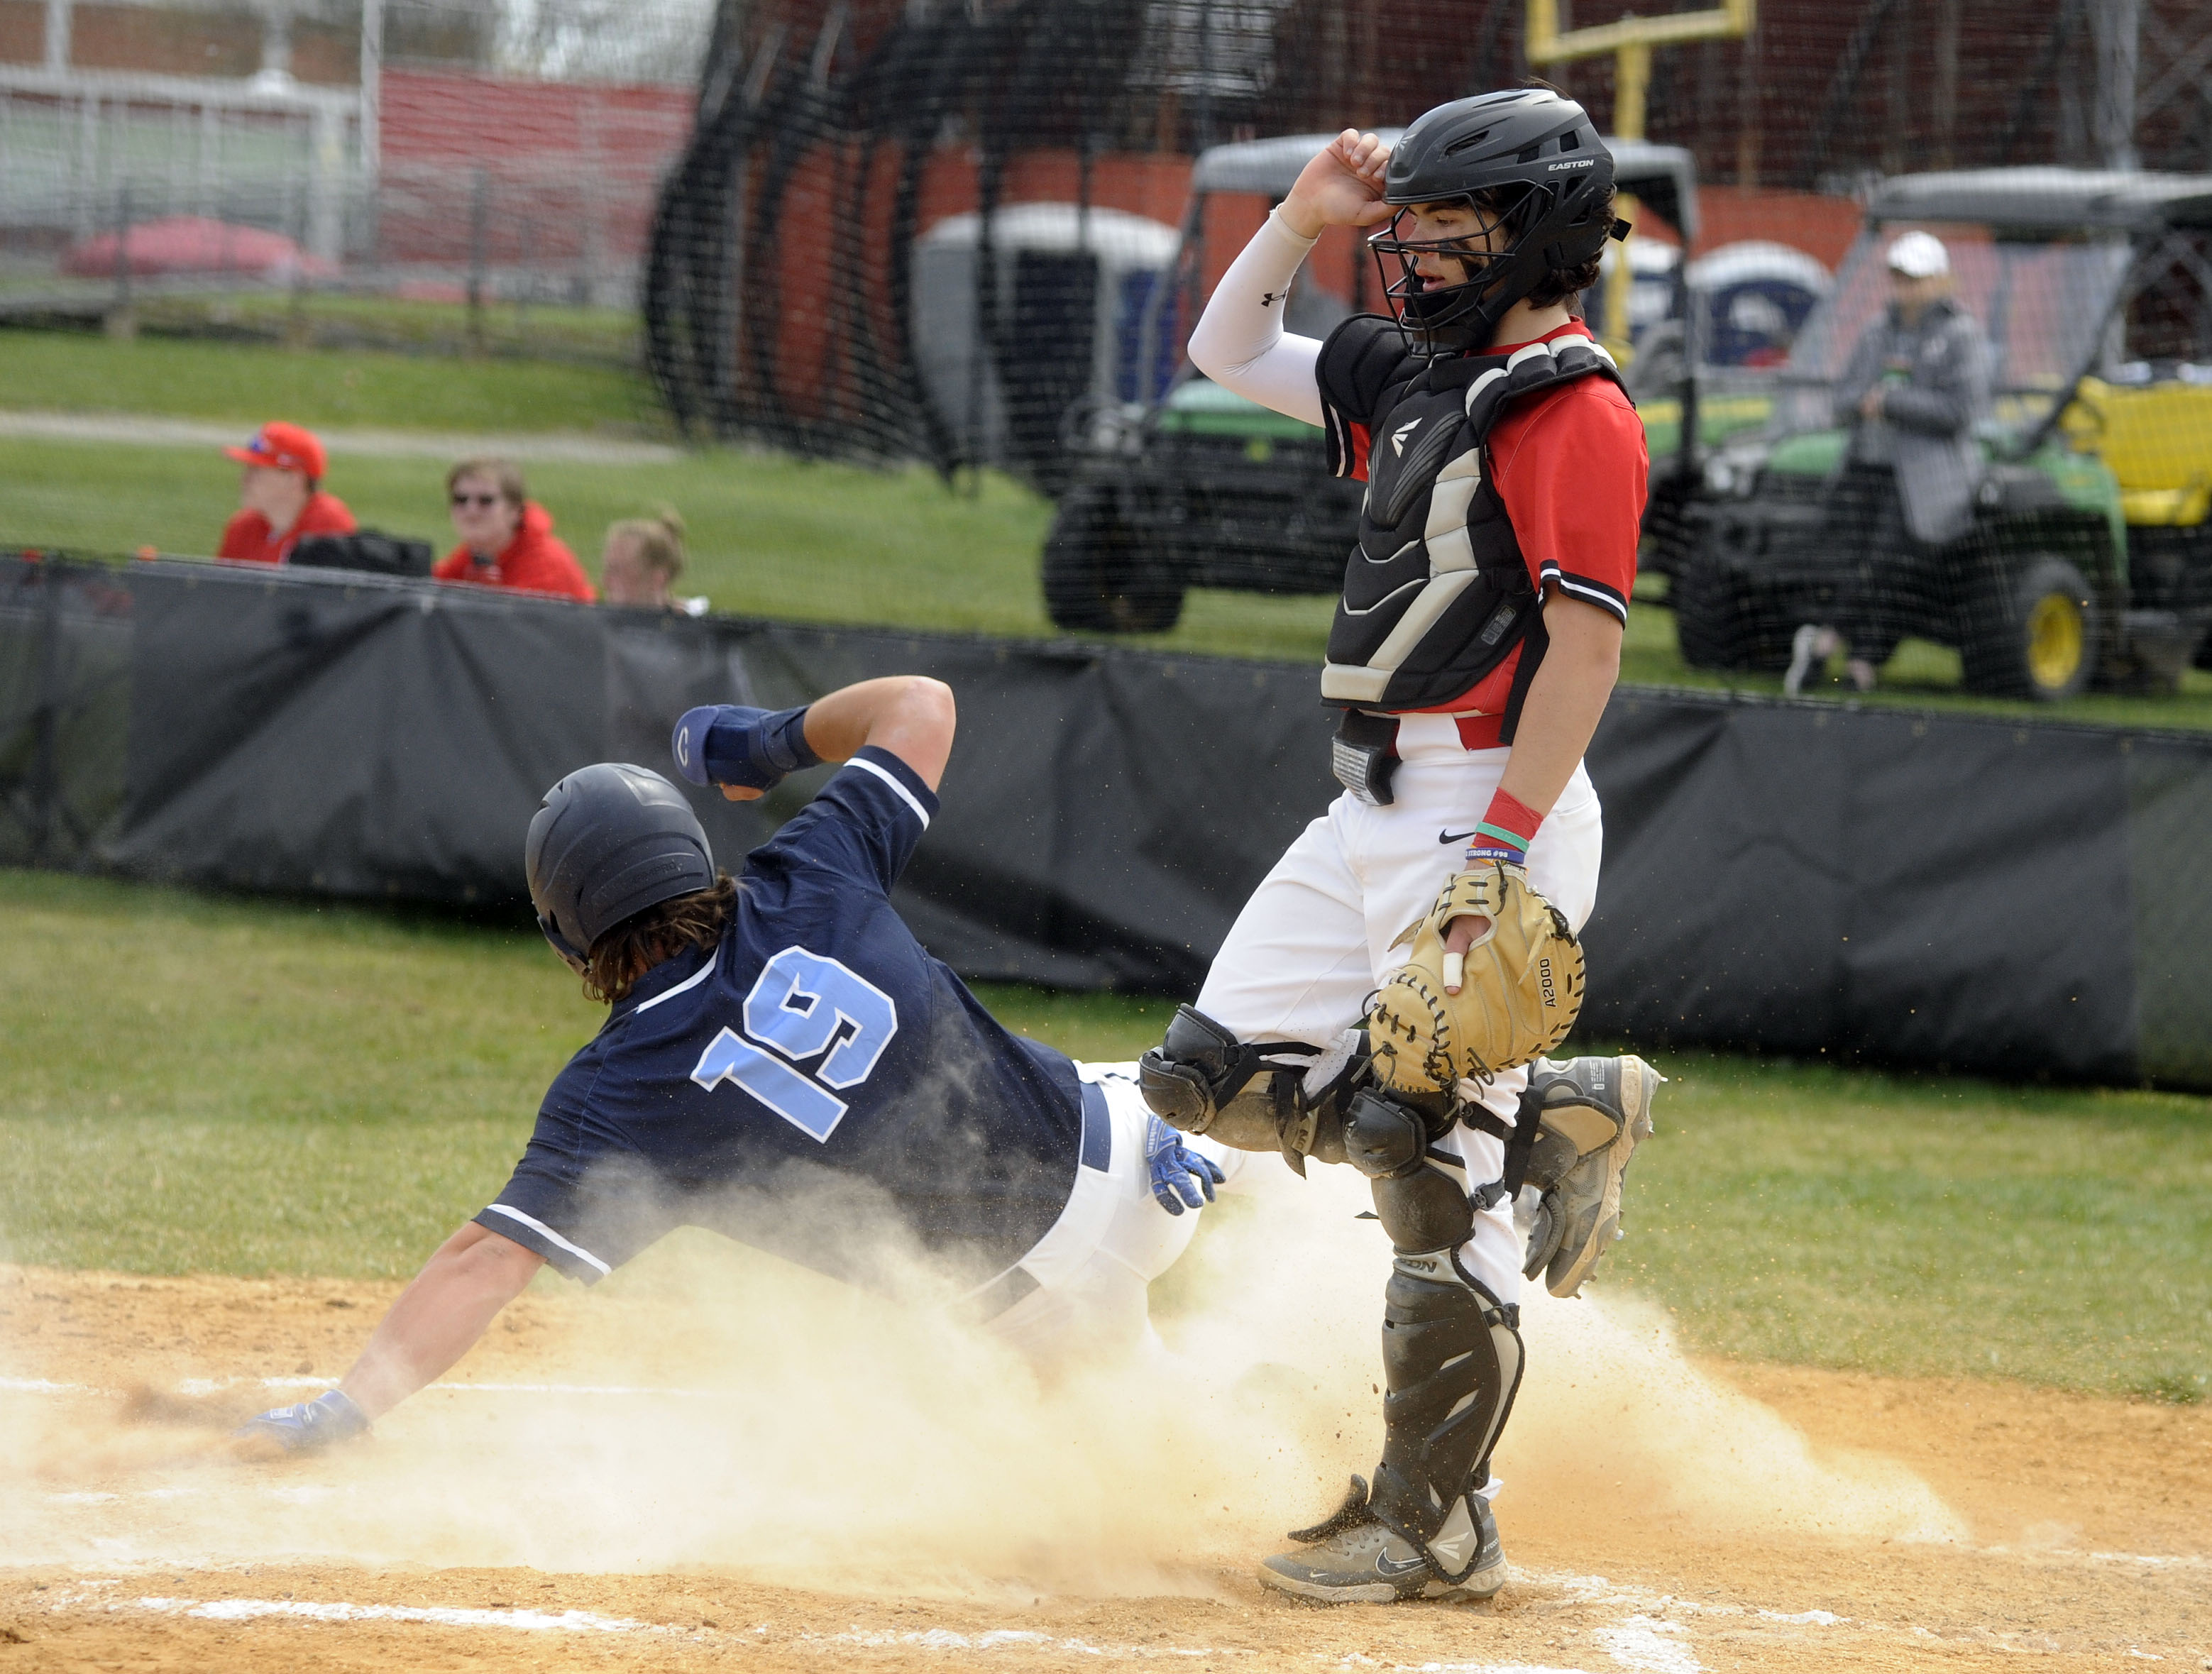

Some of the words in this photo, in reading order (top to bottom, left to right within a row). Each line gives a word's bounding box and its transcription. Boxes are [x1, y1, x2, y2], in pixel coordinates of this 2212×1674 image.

[1548, 159, 1594, 172] EASTON
[1539, 958, 1556, 1008] A2000
[689, 945, 898, 1144] 19
